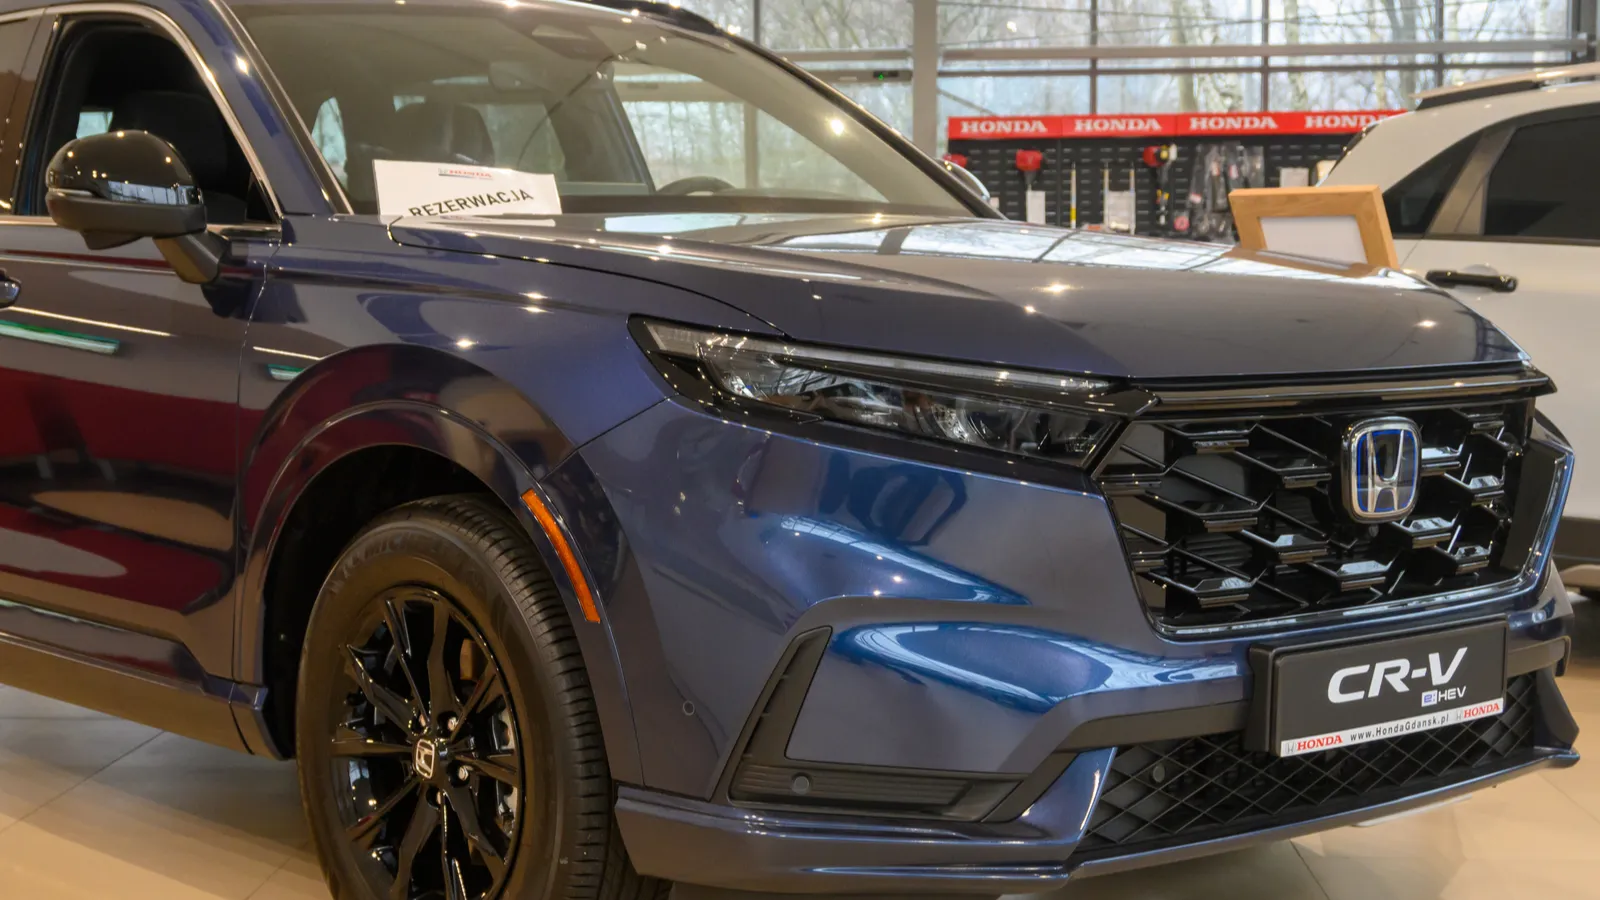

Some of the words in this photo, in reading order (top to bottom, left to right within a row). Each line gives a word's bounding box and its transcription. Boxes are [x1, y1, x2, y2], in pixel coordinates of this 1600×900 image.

[960, 120, 1048, 134] HONDA
[1074, 118, 1162, 132] HONDA
[1190, 115, 1278, 130] HONDA
[1304, 114, 1388, 129] HOND
[408, 189, 534, 216] REZERWACJA
[1327, 646, 1468, 704] CR-V
[1297, 734, 1343, 751] HONDA
[1350, 713, 1449, 742] www.HondaGdansk.pl
[1463, 703, 1500, 719] HONDA
